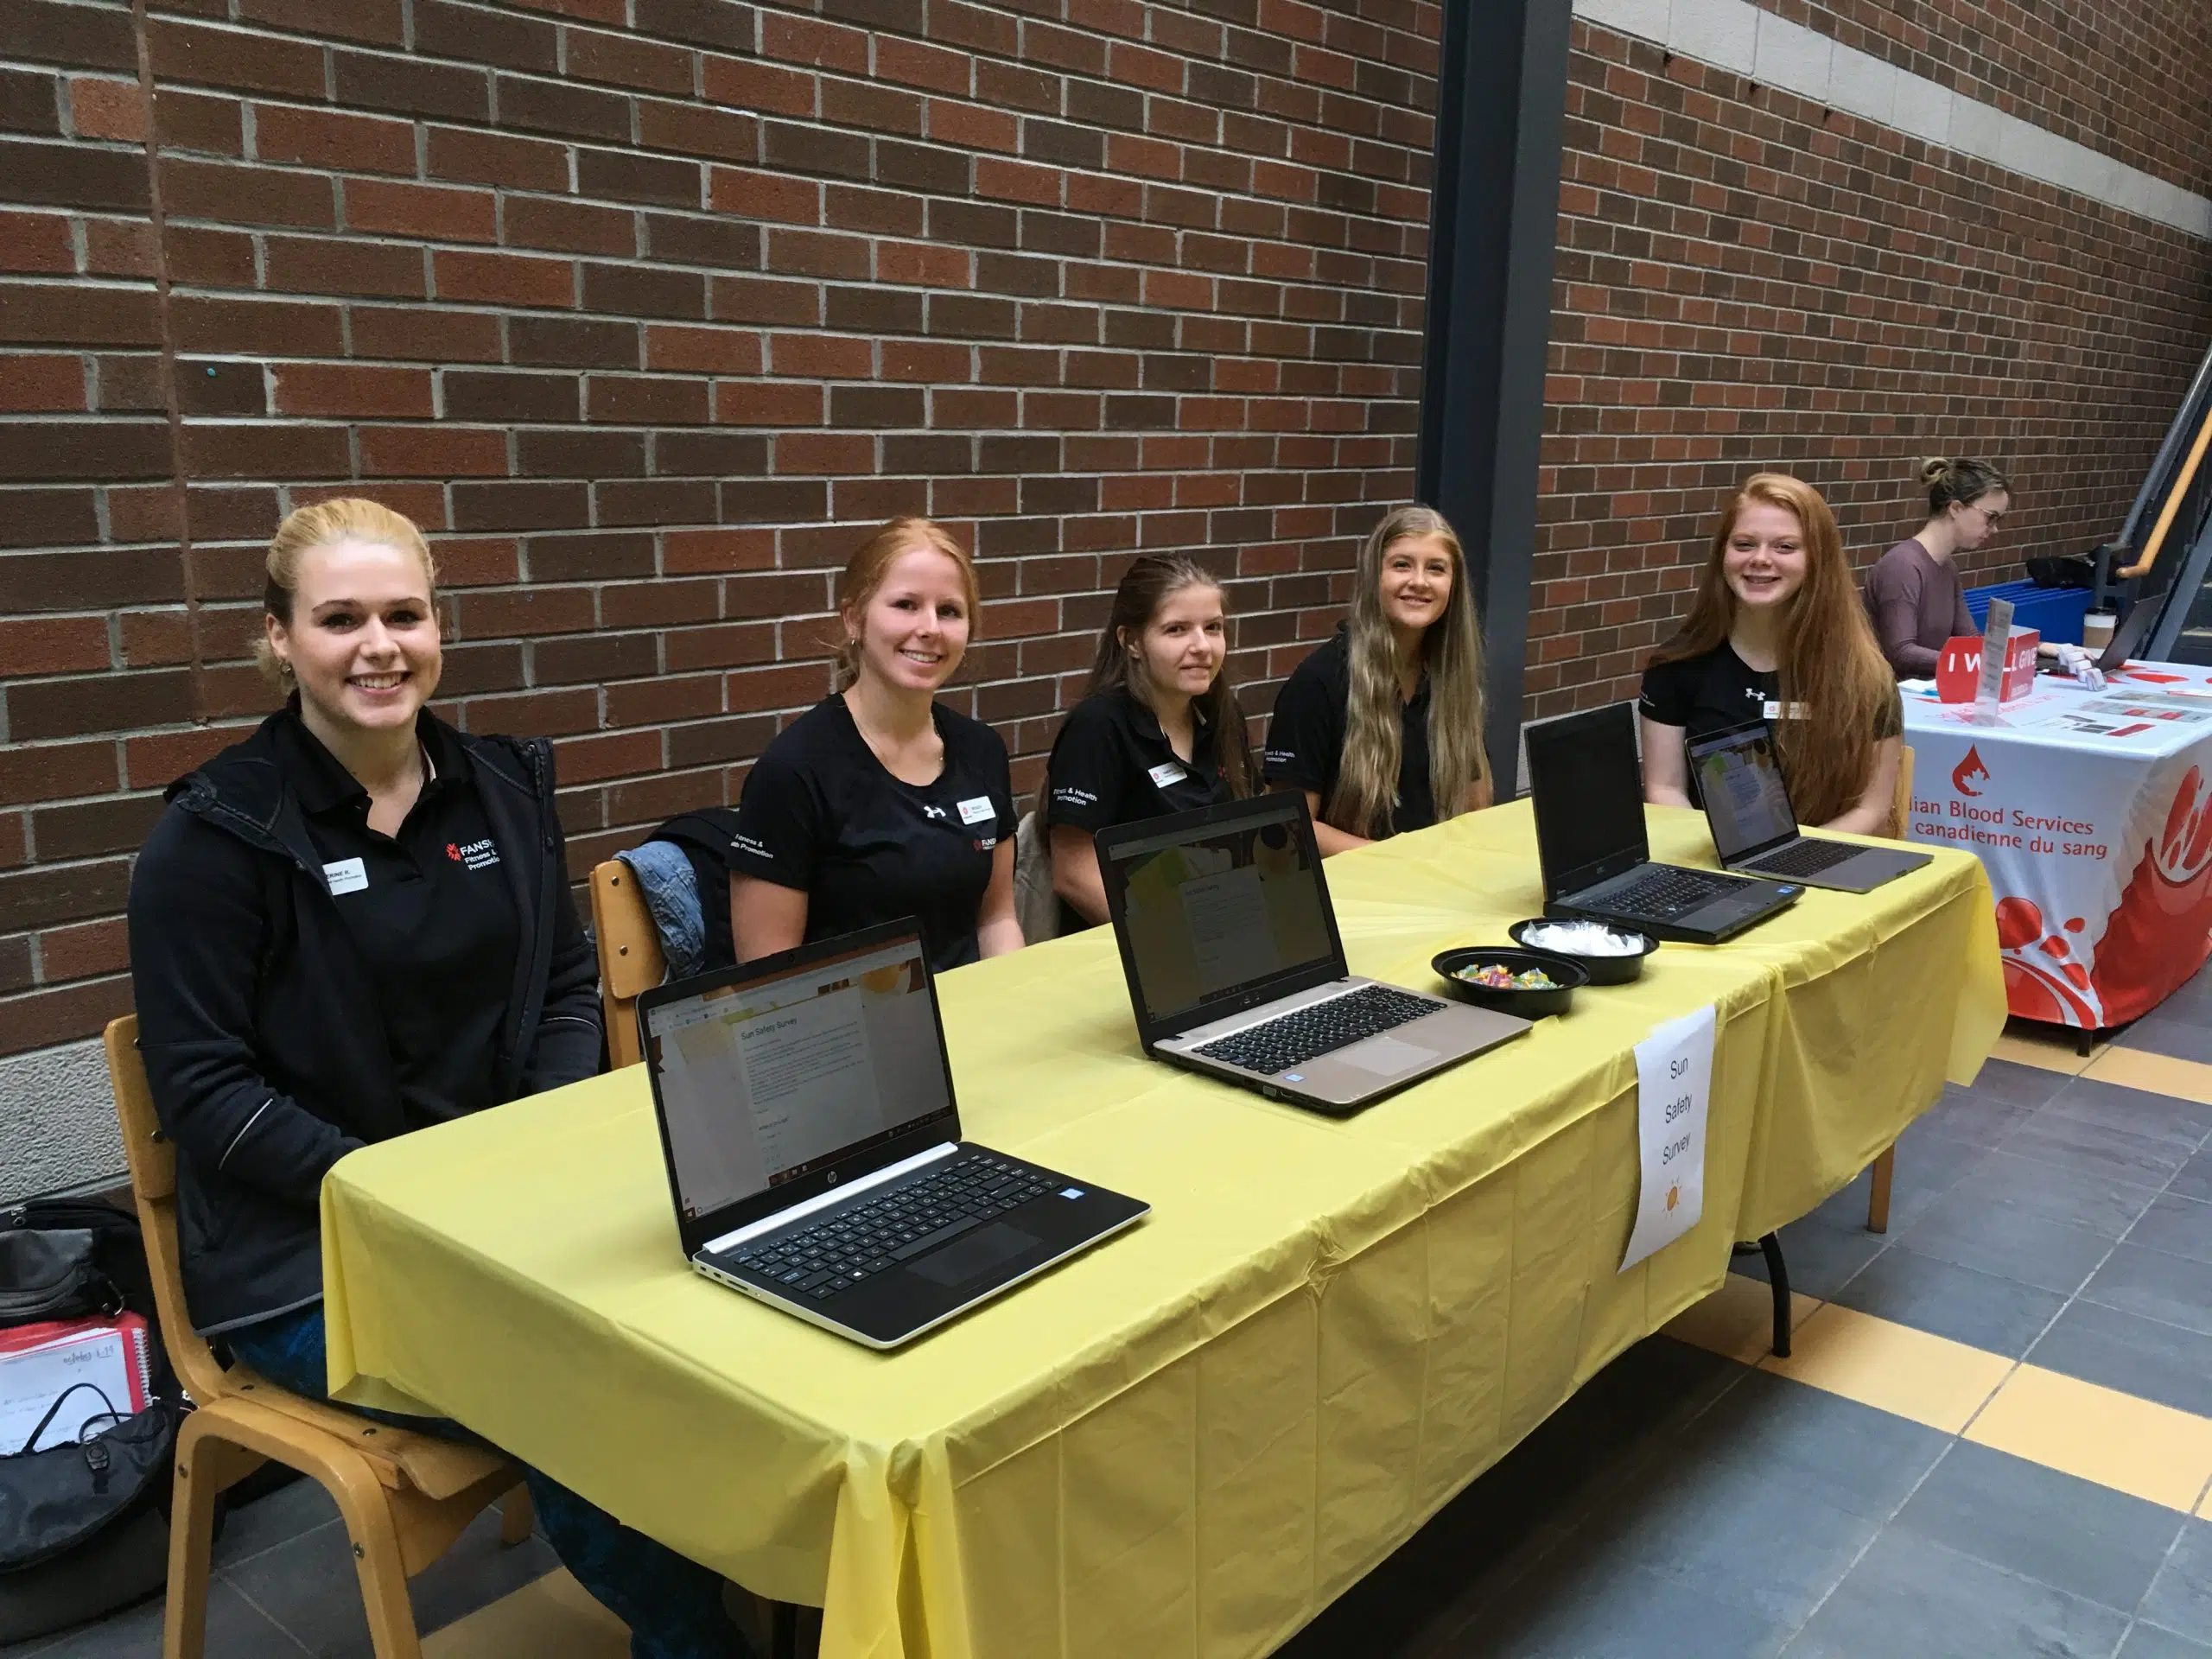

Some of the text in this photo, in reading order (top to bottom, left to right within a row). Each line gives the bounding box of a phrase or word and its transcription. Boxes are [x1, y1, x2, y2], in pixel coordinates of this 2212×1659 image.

[1074, 788, 1097, 802] Health
[1949, 800, 2004, 824] Blood
[2012, 810, 2094, 836] Services
[1915, 822, 2108, 860] canadienne du sang
[464, 851, 491, 864] Fitness
[741, 1031, 754, 1040] Sun
[755, 1025, 776, 1036] Safety
[1670, 1057, 1688, 1080] Sun
[1665, 1093, 1693, 1124] Safety
[1662, 1131, 1691, 1166] Survey
